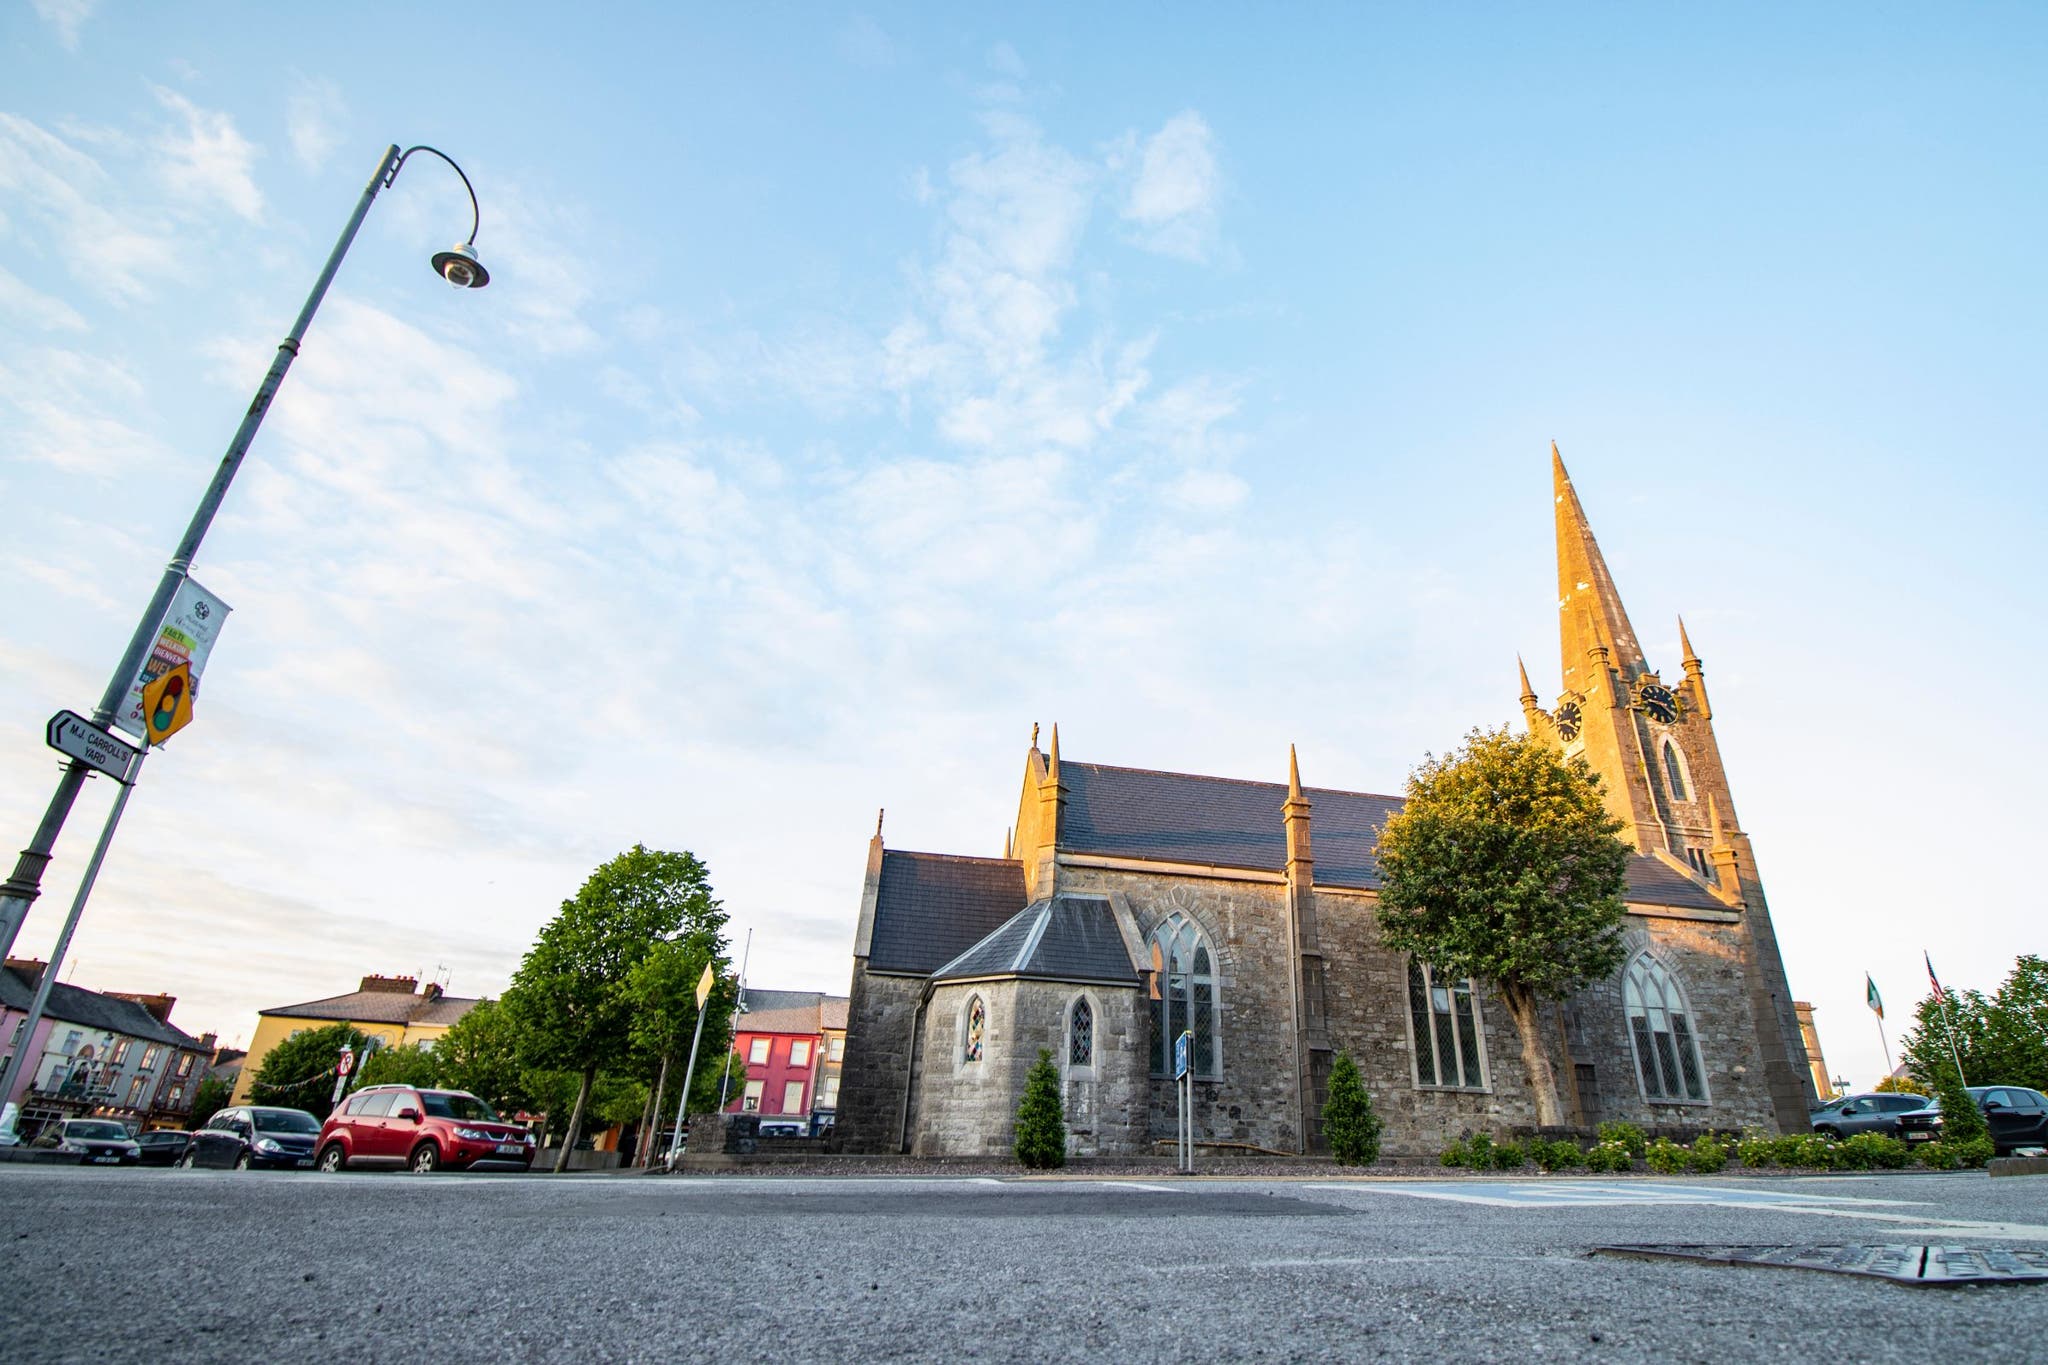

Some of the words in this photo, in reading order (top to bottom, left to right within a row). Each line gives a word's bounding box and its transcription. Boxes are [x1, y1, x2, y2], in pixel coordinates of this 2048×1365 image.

[70, 723, 85, 740] M.J.
[87, 734, 129, 762] CARROLL'S
[84, 746, 106, 764] YARD
